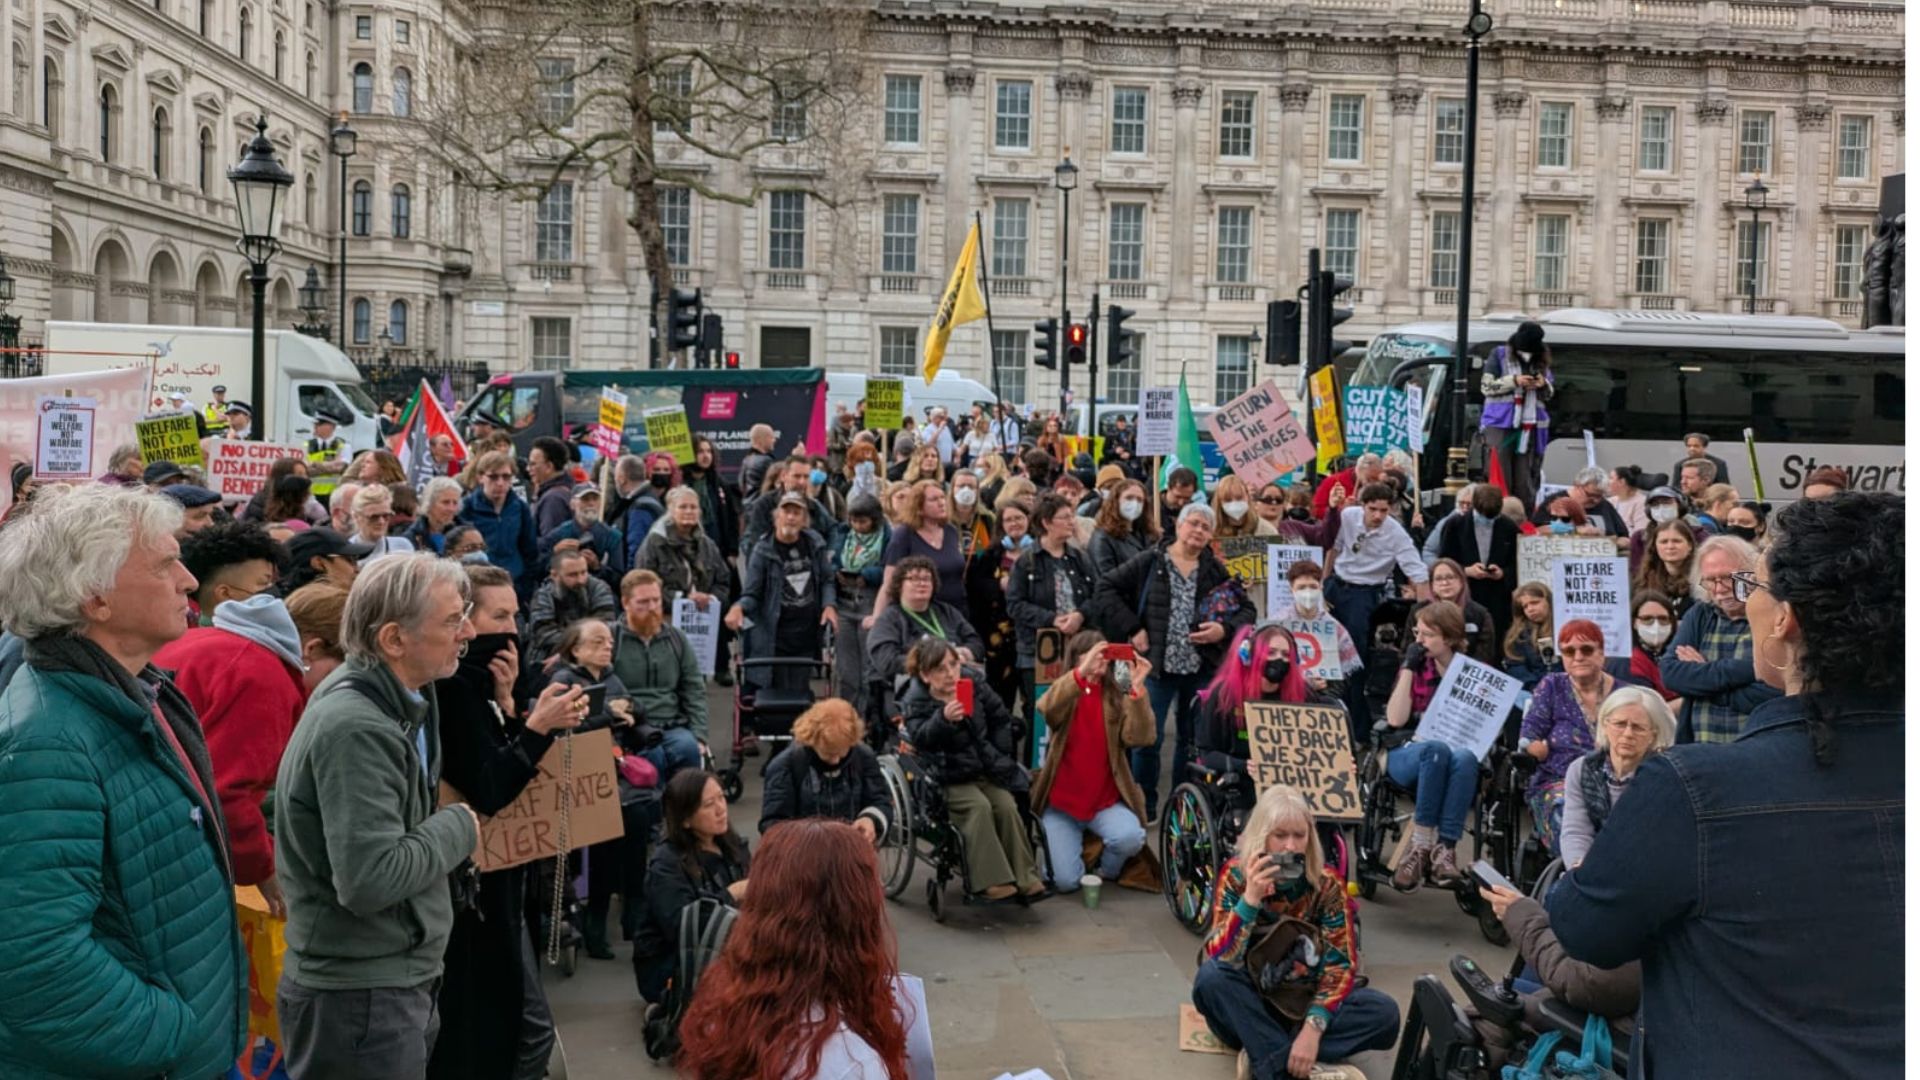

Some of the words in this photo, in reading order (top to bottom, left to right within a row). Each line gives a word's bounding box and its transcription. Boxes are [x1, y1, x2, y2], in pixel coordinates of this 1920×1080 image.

[160, 383, 192, 394] Cargo
[1146, 391, 1173, 400] WELFARE
[1348, 388, 1385, 405] CUT
[1146, 401, 1159, 410] NOT
[1216, 389, 1273, 432] RETURN
[1347, 404, 1386, 420] WAR
[59, 413, 78, 421] FUND
[1145, 411, 1173, 419] WARFARE
[51, 421, 83, 431] WELFARE
[139, 417, 192, 435] WELFARE
[1234, 419, 1268, 442] THE
[1347, 420, 1385, 436] NOT
[61, 431, 74, 439] NOT
[142, 434, 166, 449] NOT
[49, 439, 83, 448] WARFARE
[221, 444, 245, 457] NO
[248, 445, 284, 459] CUTS
[1233, 423, 1298, 468] SAUSAGES
[145, 443, 199, 463] WARFARE
[1278, 549, 1312, 559] WELFARE
[1563, 562, 1615, 576] WELFARE
[1564, 577, 1587, 590] NOT
[1565, 591, 1617, 604] WARFARE
[1455, 673, 1478, 691] NOT
[1461, 662, 1509, 692] WELFARE
[1449, 685, 1498, 717] WARFARE
[1252, 706, 1301, 727] THEY
[1305, 709, 1343, 731] SAY
[1254, 725, 1295, 745] CUT
[1298, 729, 1348, 751] BACK
[1258, 745, 1289, 763] WE
[1293, 747, 1336, 769] SAY
[1258, 763, 1322, 788] FIGHT
[555, 772, 613, 811] MATE
